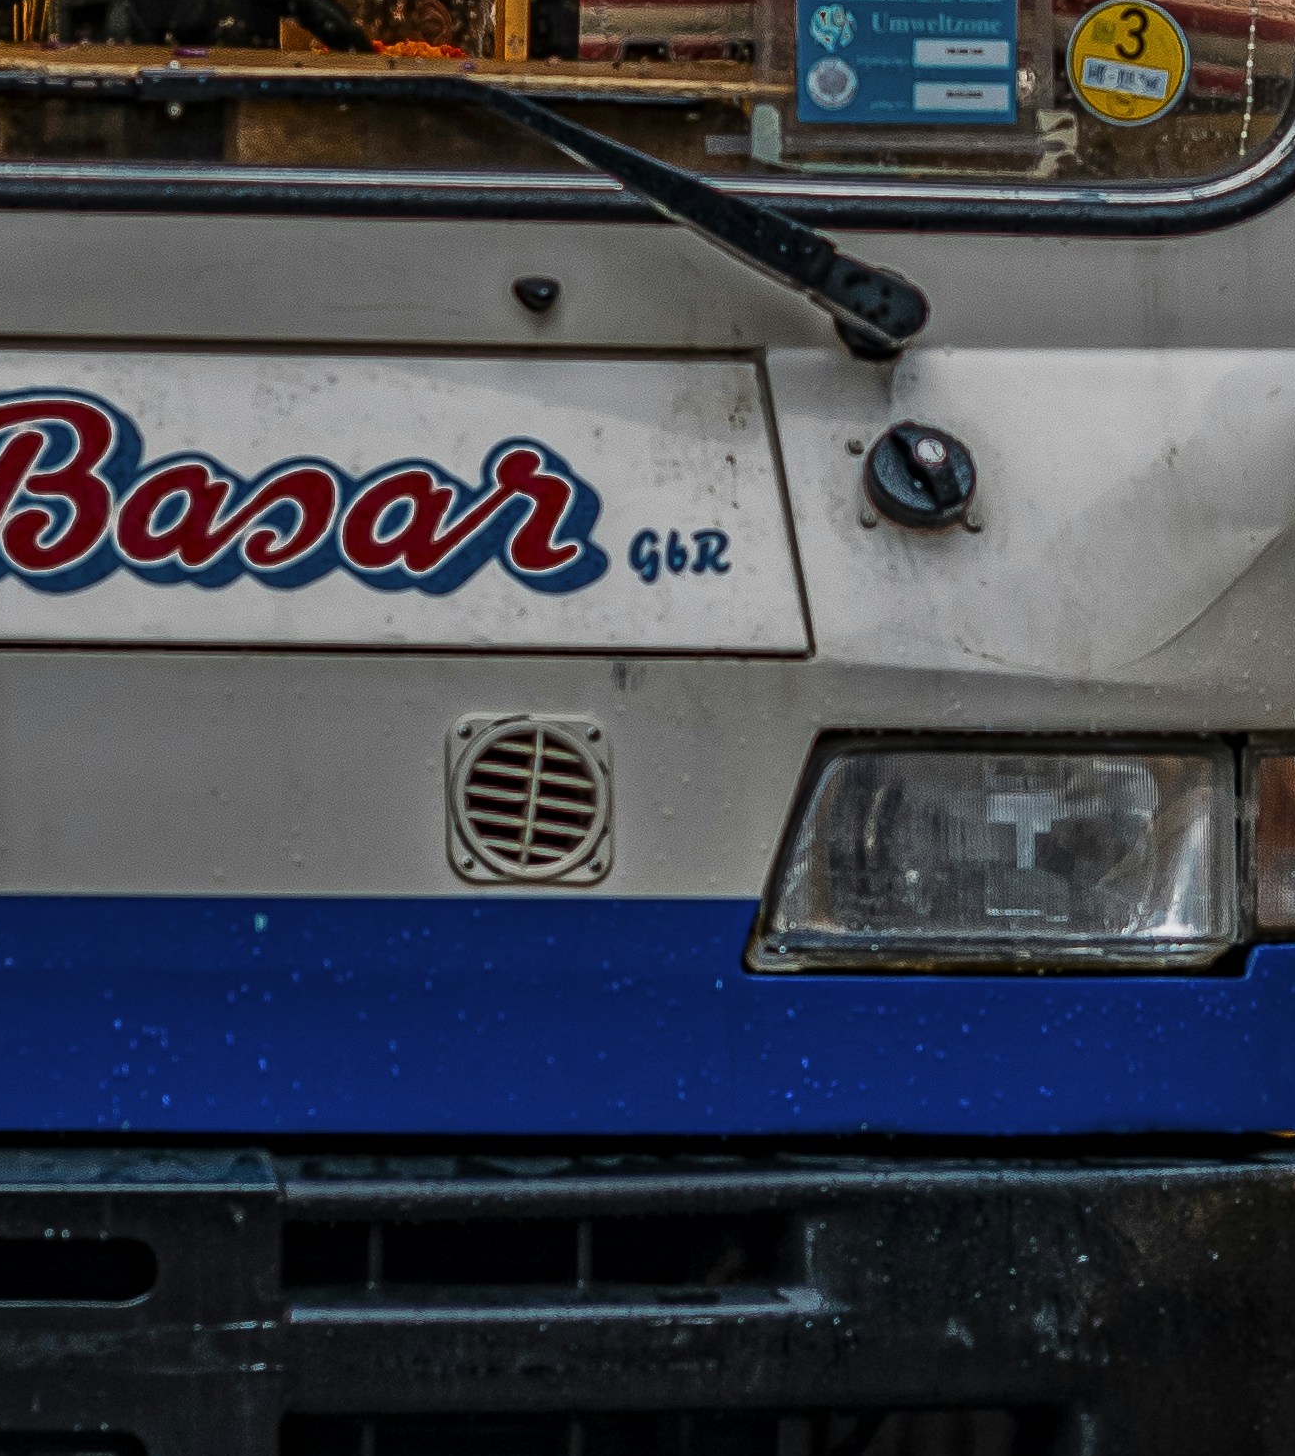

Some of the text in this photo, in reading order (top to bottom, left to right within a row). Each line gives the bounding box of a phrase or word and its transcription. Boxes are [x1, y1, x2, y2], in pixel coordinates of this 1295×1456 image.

[871, 11, 1003, 35] Umweltzone
[1115, 7, 1150, 60] 3
[628, 526, 732, 586] GbR
